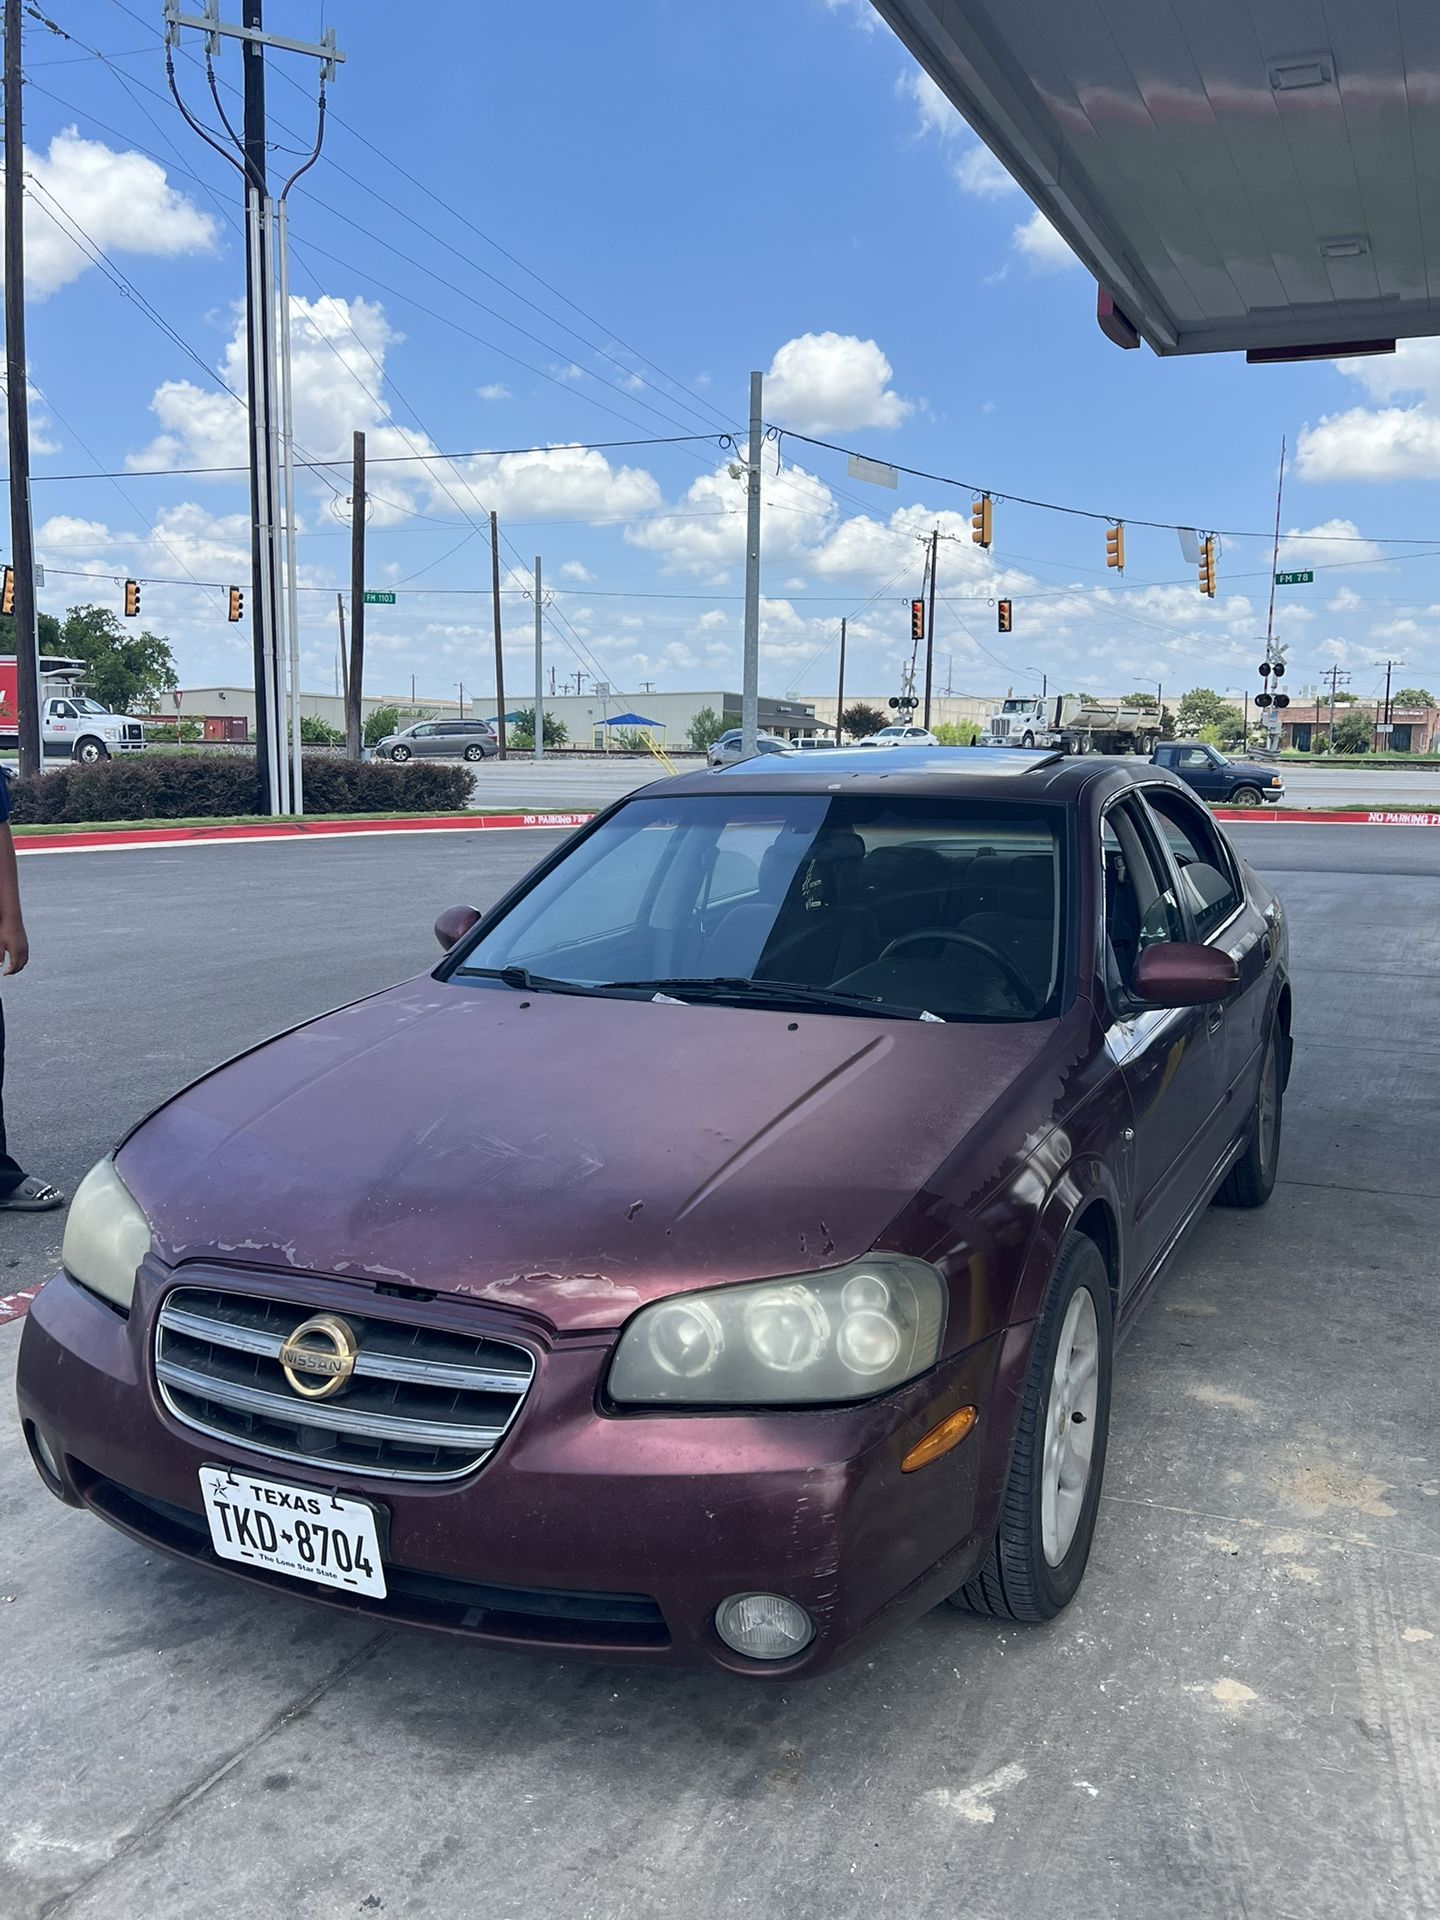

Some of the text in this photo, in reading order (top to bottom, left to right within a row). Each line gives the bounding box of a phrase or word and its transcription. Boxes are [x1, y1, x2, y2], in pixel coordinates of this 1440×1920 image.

[1280, 573, 1309, 583] FM 78
[366, 593, 393, 603] FM 1103
[523, 815, 536, 824] NO
[538, 815, 572, 824] PARKING
[1368, 812, 1384, 822] NO
[1385, 812, 1429, 824] PARKING
[284, 1350, 342, 1372] NISSAN
[250, 1485, 321, 1515] TEXAS
[259, 1553, 338, 1579] The Lone Star State
